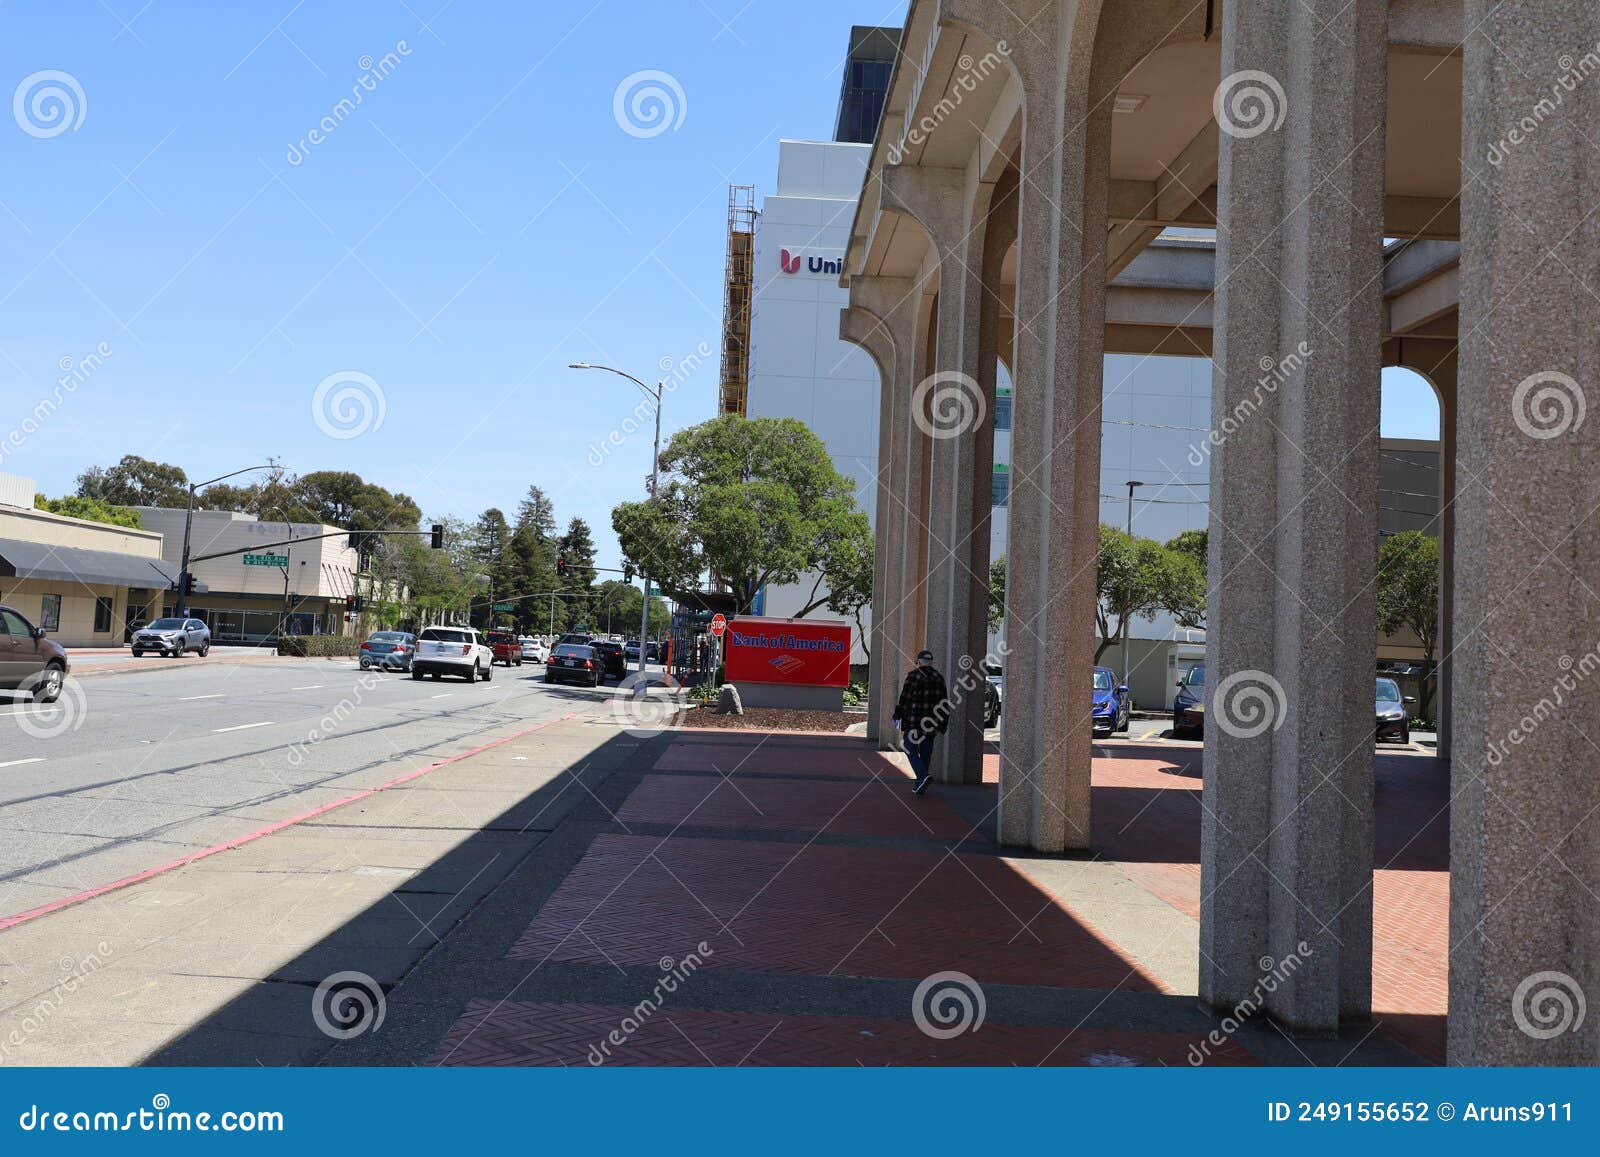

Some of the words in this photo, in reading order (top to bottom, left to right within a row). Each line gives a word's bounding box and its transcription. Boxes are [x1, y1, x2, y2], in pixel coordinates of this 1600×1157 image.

[712, 619, 726, 630] STOP
[732, 631, 768, 648] Bank
[770, 634, 785, 648] of
[786, 634, 845, 652] America
